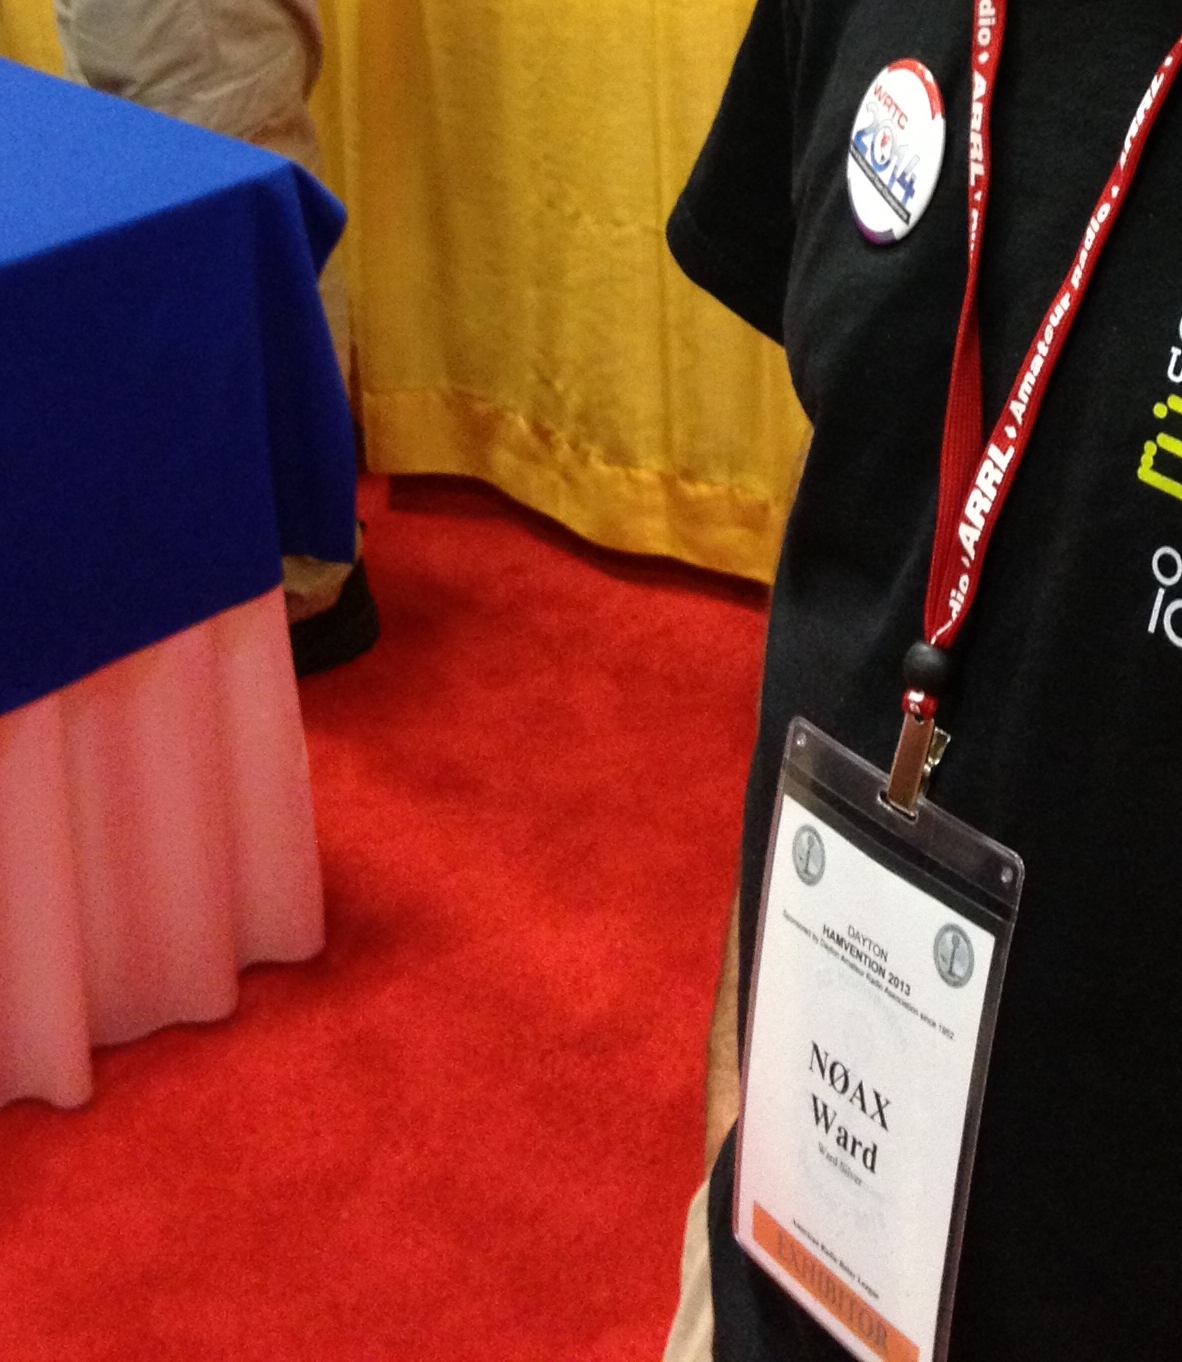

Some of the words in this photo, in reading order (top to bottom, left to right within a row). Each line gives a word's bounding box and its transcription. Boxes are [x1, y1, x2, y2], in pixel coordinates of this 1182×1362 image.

[969, 70, 988, 187] ARRL
[957, 442, 1016, 561] ARRL
[1009, 292, 1072, 426] Amateur
[1070, 203, 1111, 290] Radio
[822, 924, 887, 980] HAMVENTION
[888, 972, 912, 997] 2013
[847, 923, 889, 963] DAYTON
[811, 1092, 879, 1175] Ward
